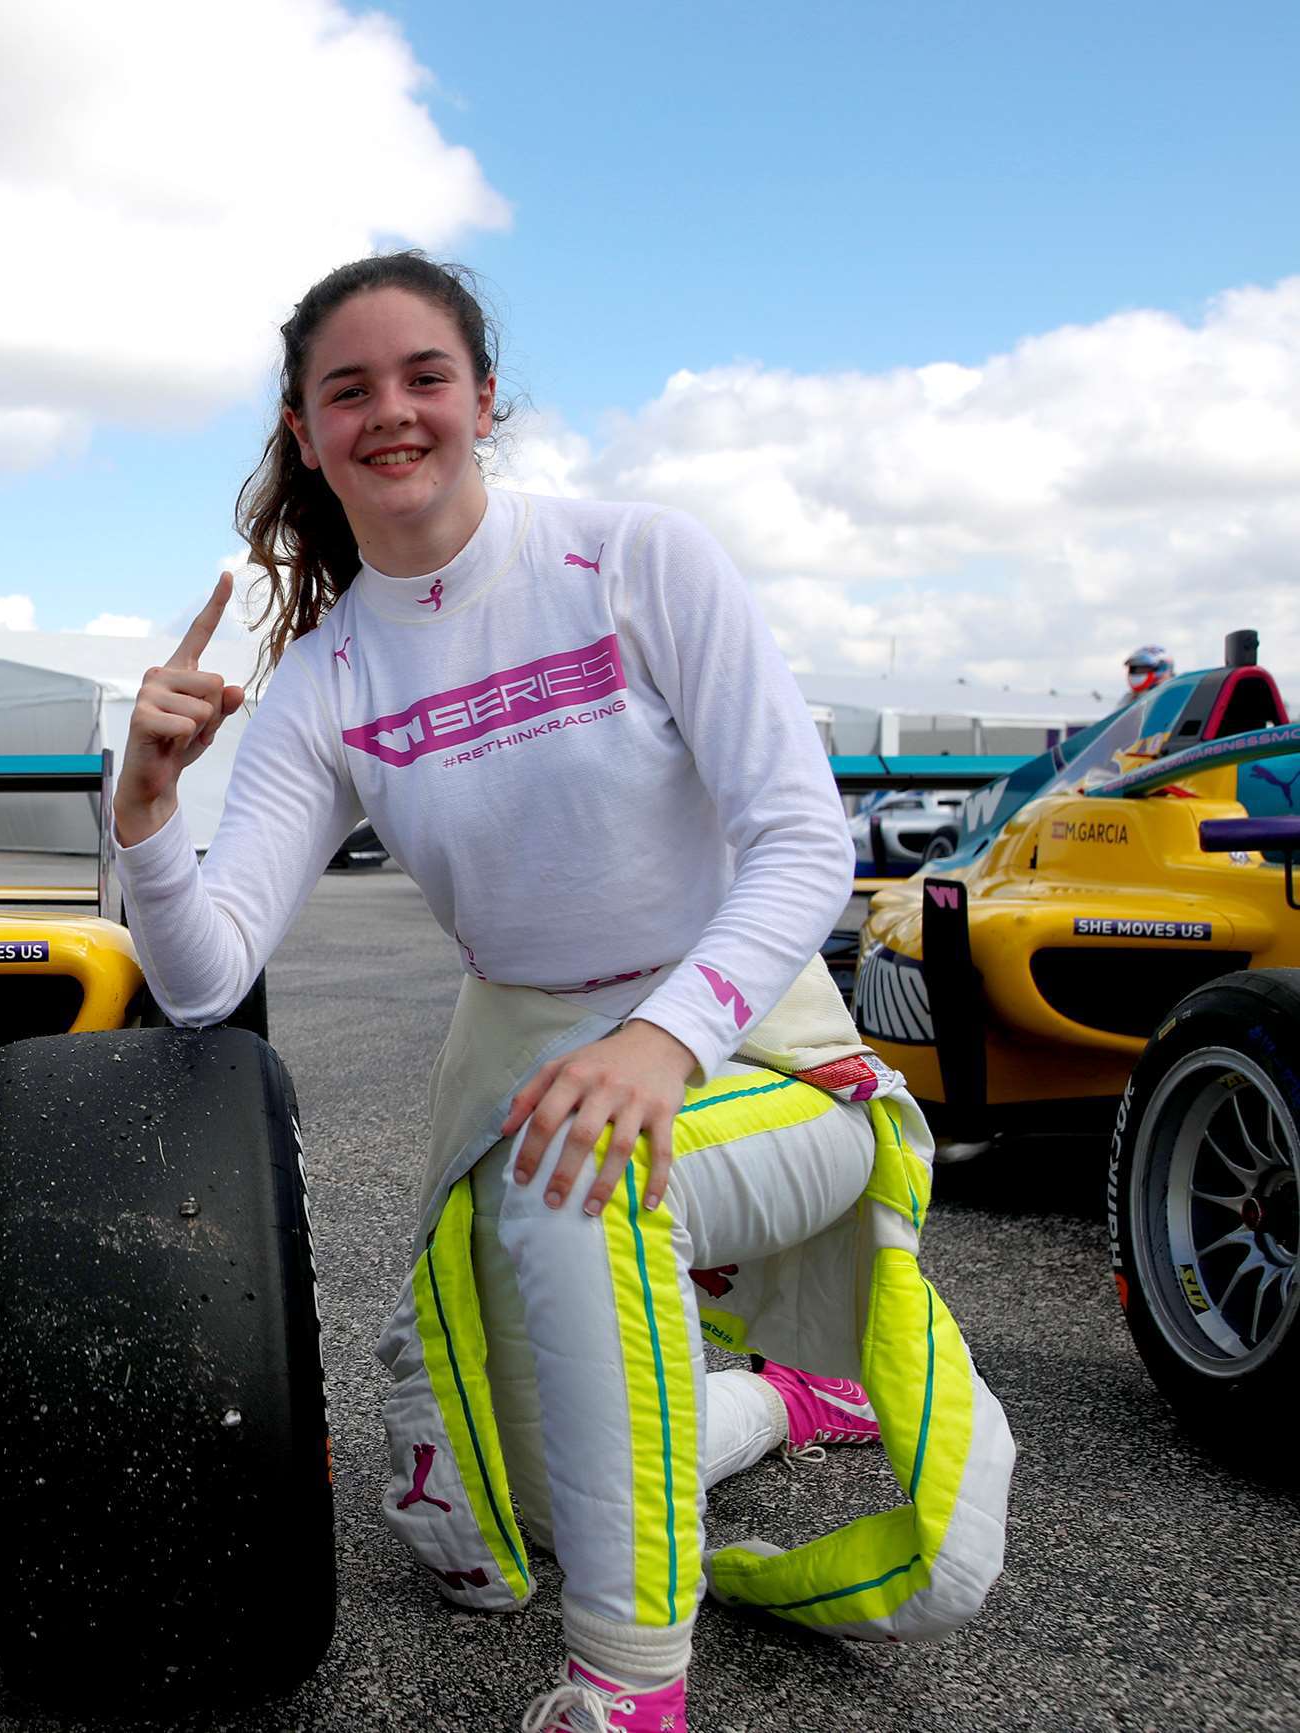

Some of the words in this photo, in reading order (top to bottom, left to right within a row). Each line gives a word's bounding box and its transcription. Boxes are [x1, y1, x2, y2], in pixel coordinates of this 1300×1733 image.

[428, 651, 616, 737] SERIES
[443, 700, 627, 768] #RETHINKRACING
[1065, 823, 1129, 844] M.GARCIA
[1078, 919, 1112, 934] SHE
[1117, 920, 1177, 937] MOVES
[1181, 923, 1205, 938] US
[20, 944, 43, 959] US
